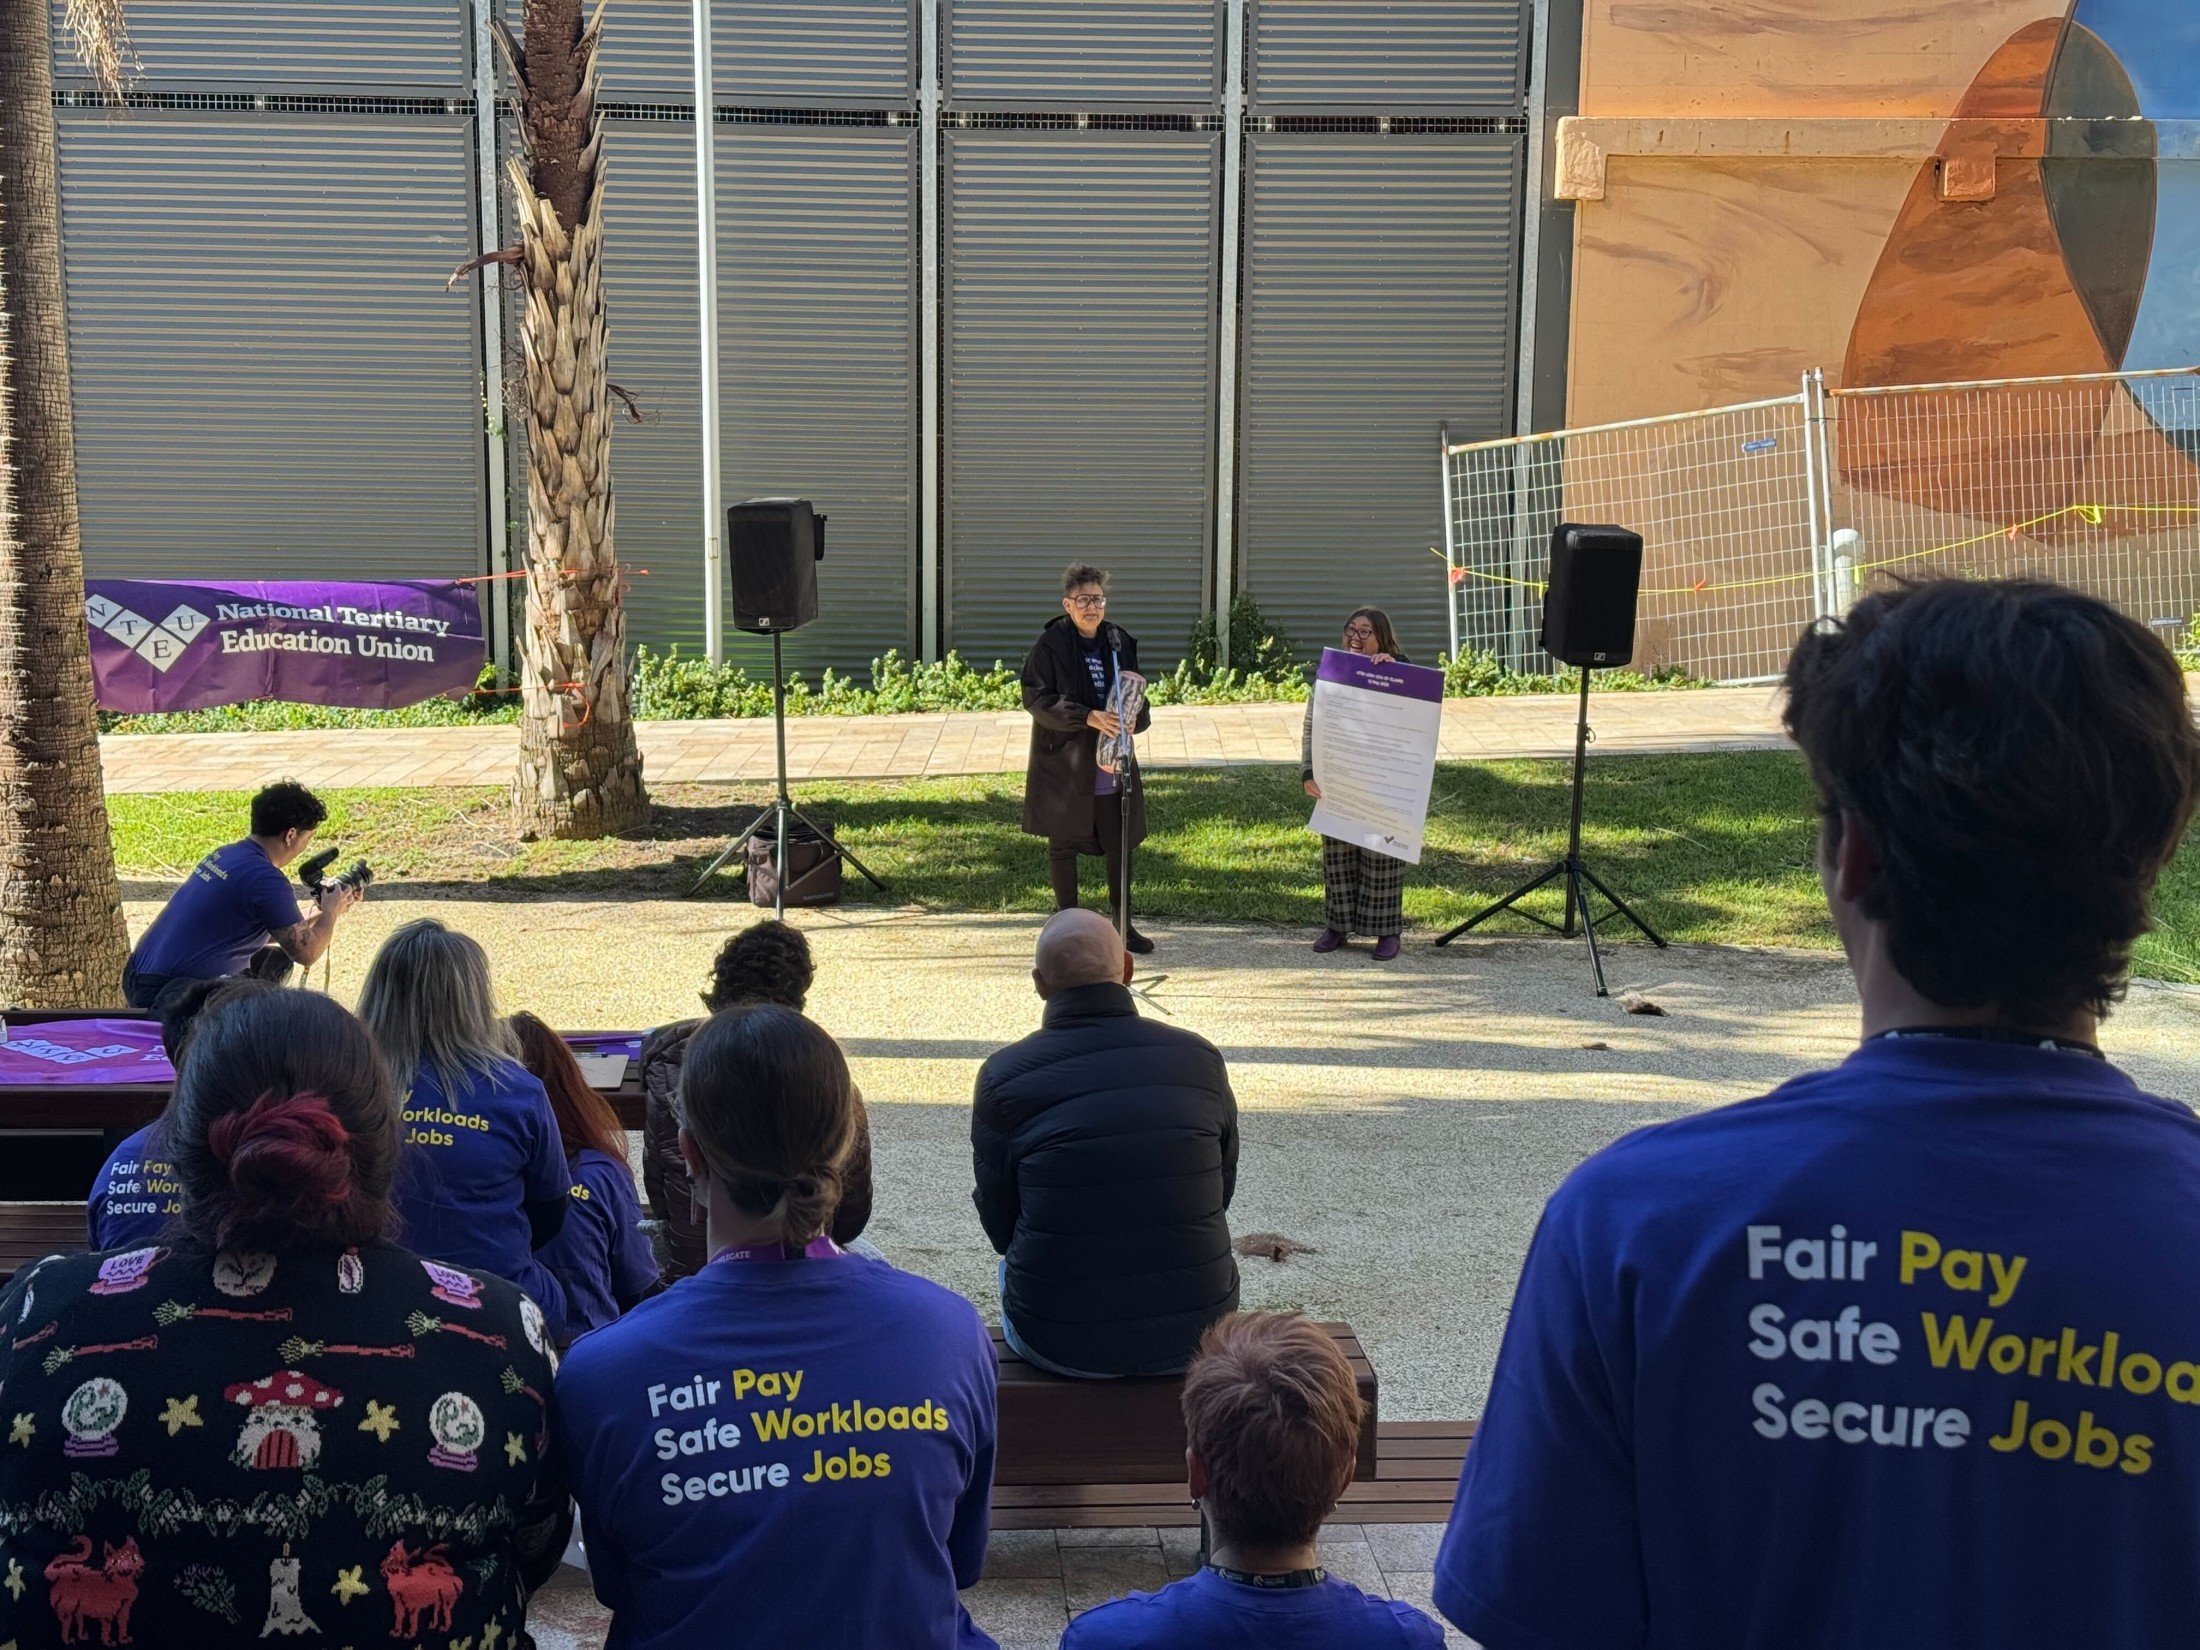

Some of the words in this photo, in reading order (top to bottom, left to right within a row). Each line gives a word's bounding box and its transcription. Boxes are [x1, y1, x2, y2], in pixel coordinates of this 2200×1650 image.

[215, 603, 335, 623] National
[336, 606, 450, 637] Tertiary
[220, 628, 352, 655] Education
[356, 635, 435, 662] Union
[402, 1107, 490, 1132] orkloads
[405, 1128, 454, 1147] Jobs
[110, 1160, 140, 1176] Fair
[107, 1179, 141, 1195] Safe
[106, 1200, 157, 1215] Secure
[110, 1255, 145, 1270] LOVE
[1746, 1224, 1878, 1281] Fair
[1900, 1230, 2029, 1308] Pay
[1747, 1303, 1901, 1365] Safe
[647, 1375, 721, 1418] Fair
[732, 1368, 804, 1402] Pay
[653, 1417, 741, 1460] Safe
[751, 1399, 949, 1443] Workloads
[1751, 1382, 1971, 1449] Secure
[1988, 1399, 2155, 1475] Jobs
[660, 1462, 790, 1506] Secure
[802, 1446, 892, 1484] Jobs
